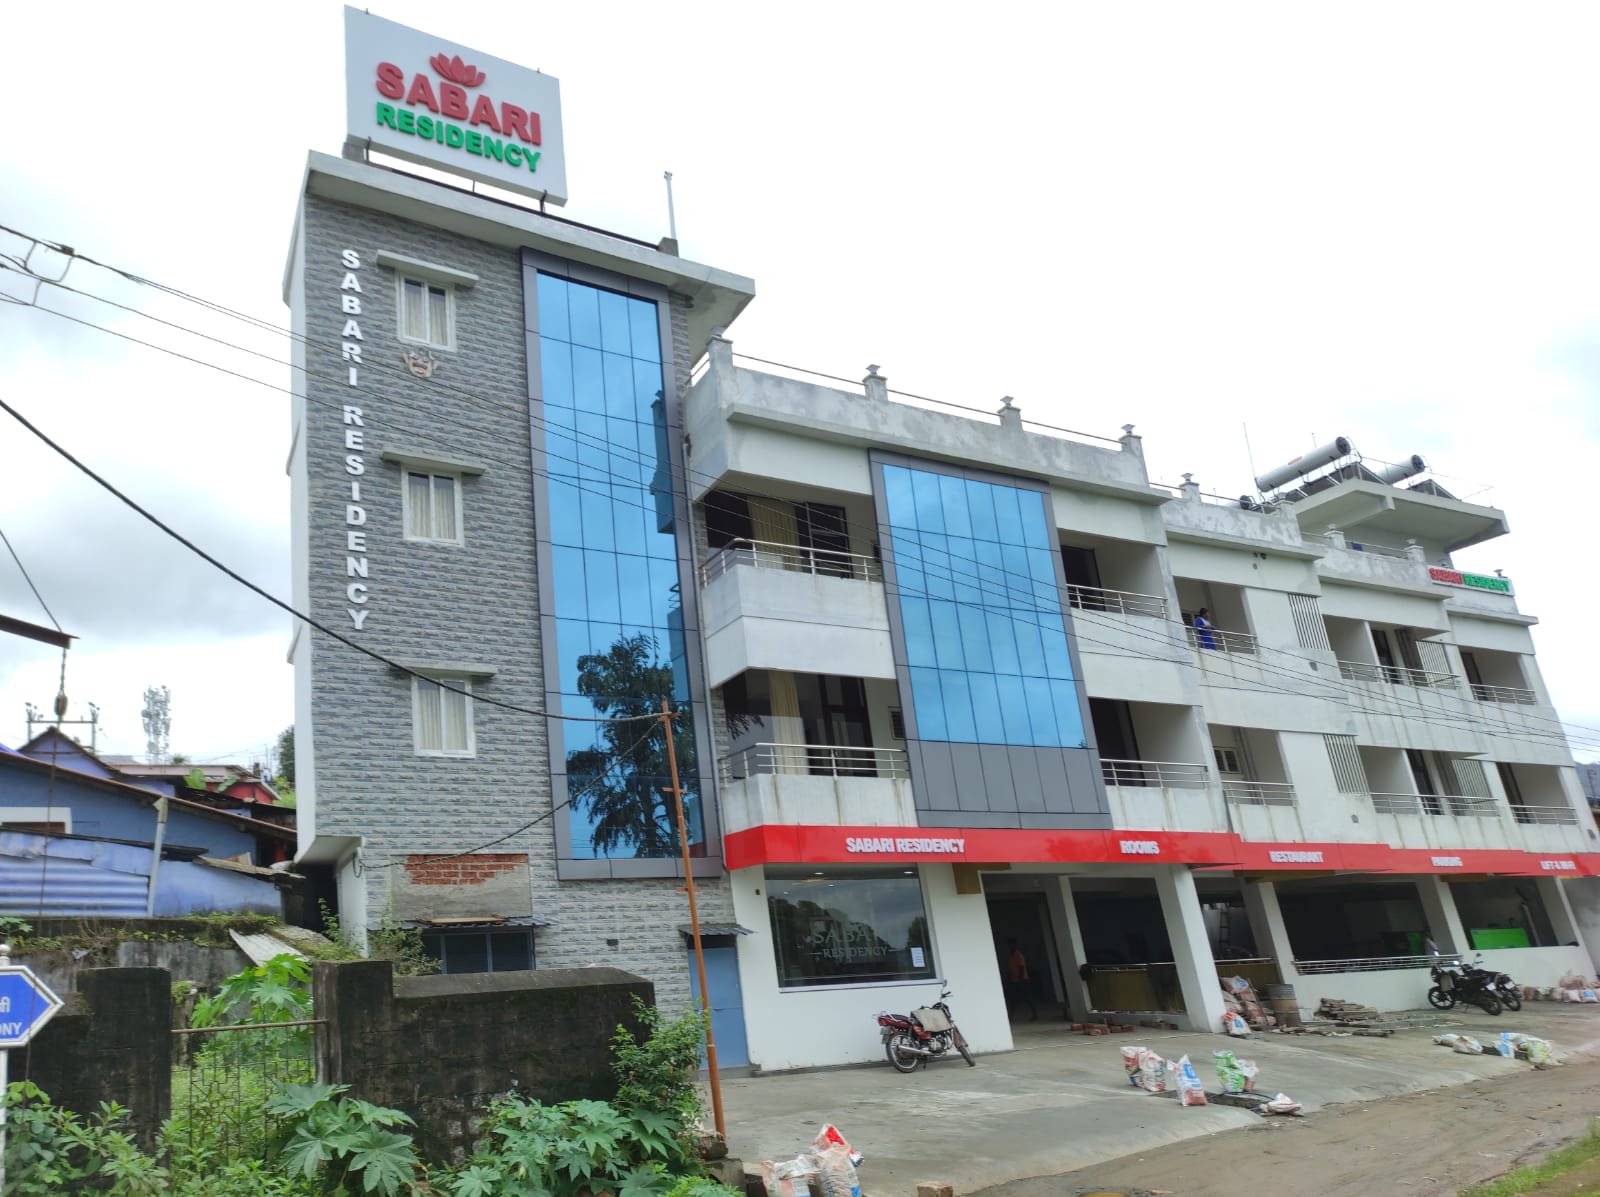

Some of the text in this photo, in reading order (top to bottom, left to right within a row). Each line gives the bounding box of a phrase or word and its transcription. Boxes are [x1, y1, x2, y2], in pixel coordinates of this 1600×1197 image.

[376, 62, 541, 146] SABARI
[376, 101, 541, 173] RESIDENCY
[340, 249, 369, 630] SABARI RESIDENCY
[845, 837, 966, 853] SABARI RESIDENCY
[1119, 840, 1160, 854] ROOMS
[0, 1021, 22, 1036] NY
